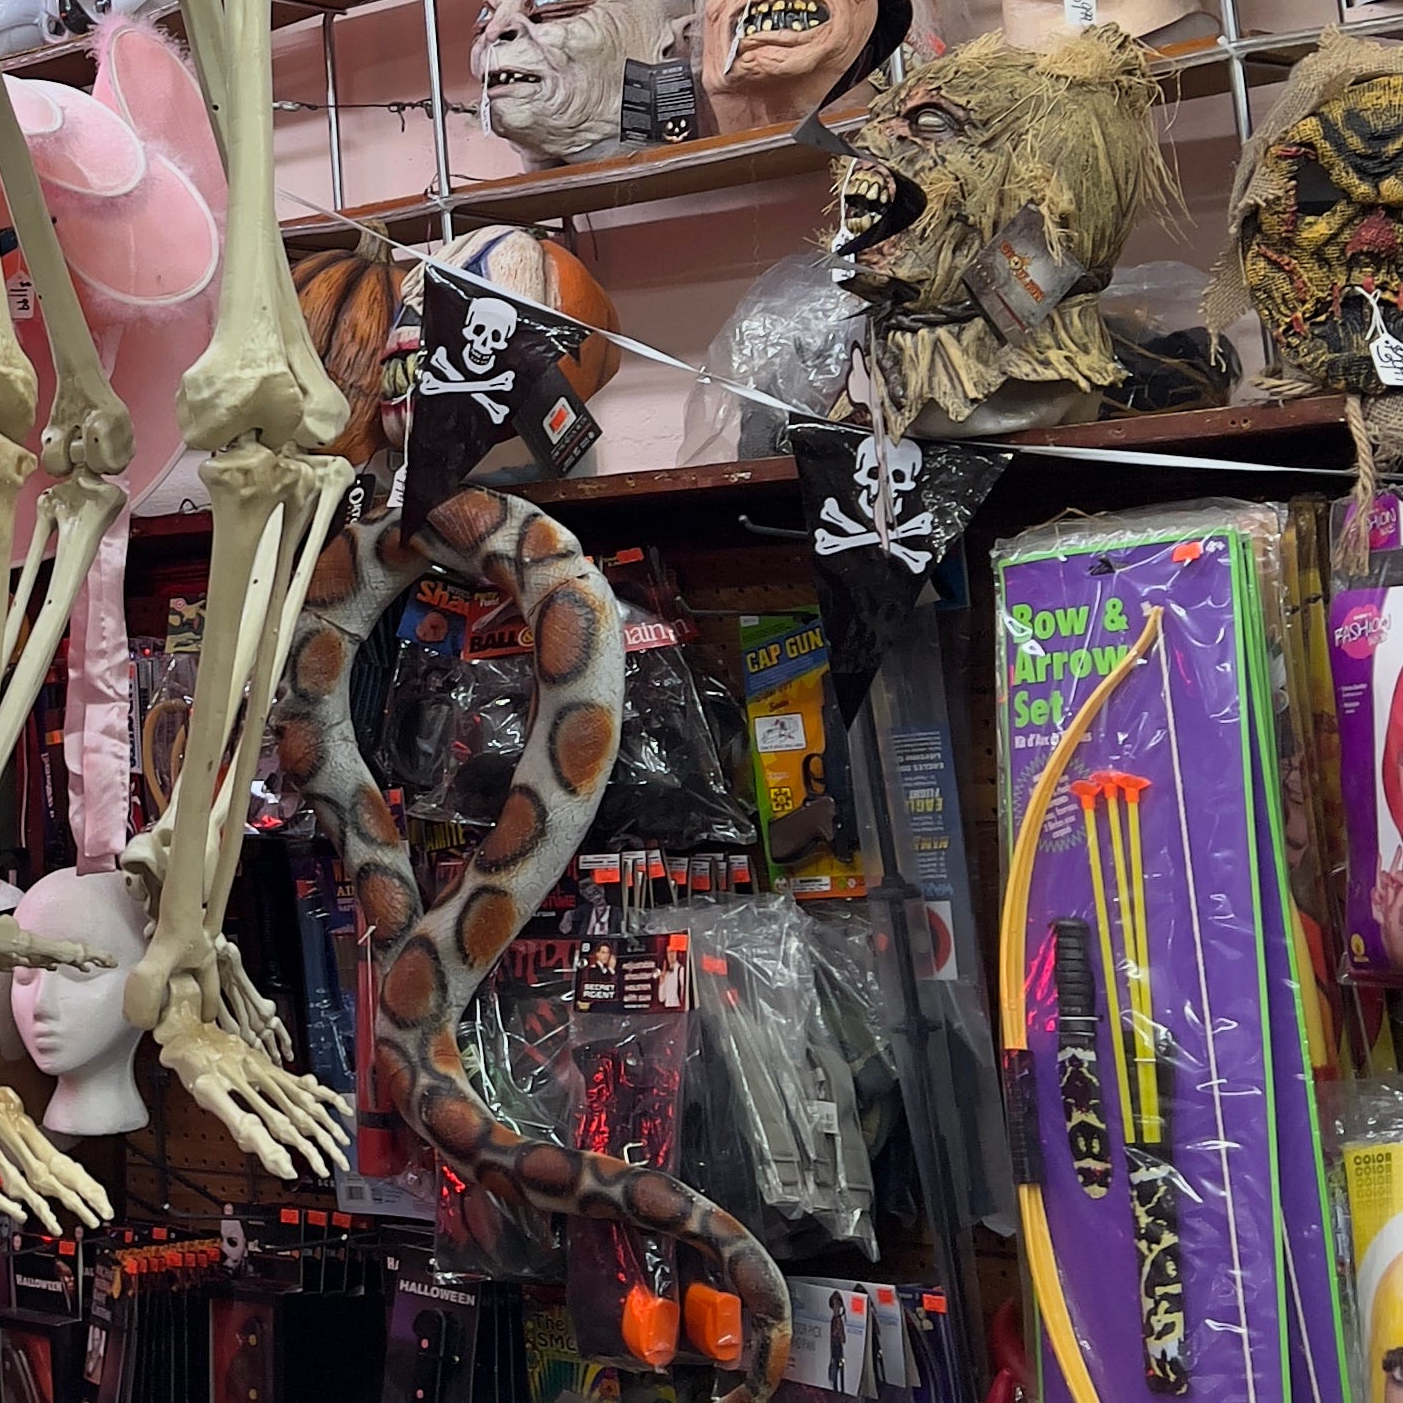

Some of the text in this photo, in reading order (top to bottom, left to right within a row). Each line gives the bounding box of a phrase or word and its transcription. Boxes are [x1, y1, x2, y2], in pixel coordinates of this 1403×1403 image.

[1012, 596, 1130, 643] Bow &
[1333, 611, 1393, 648] FASHION
[470, 631, 519, 653] BALL
[745, 642, 782, 675] CAP
[784, 626, 825, 660] GUN
[1013, 644, 1130, 686] Arrow
[1013, 690, 1067, 729] Set
[1354, 1152, 1392, 1166] COLOR
[399, 1279, 476, 1307] HALLOWEEN
[533, 1313, 566, 1332] The
